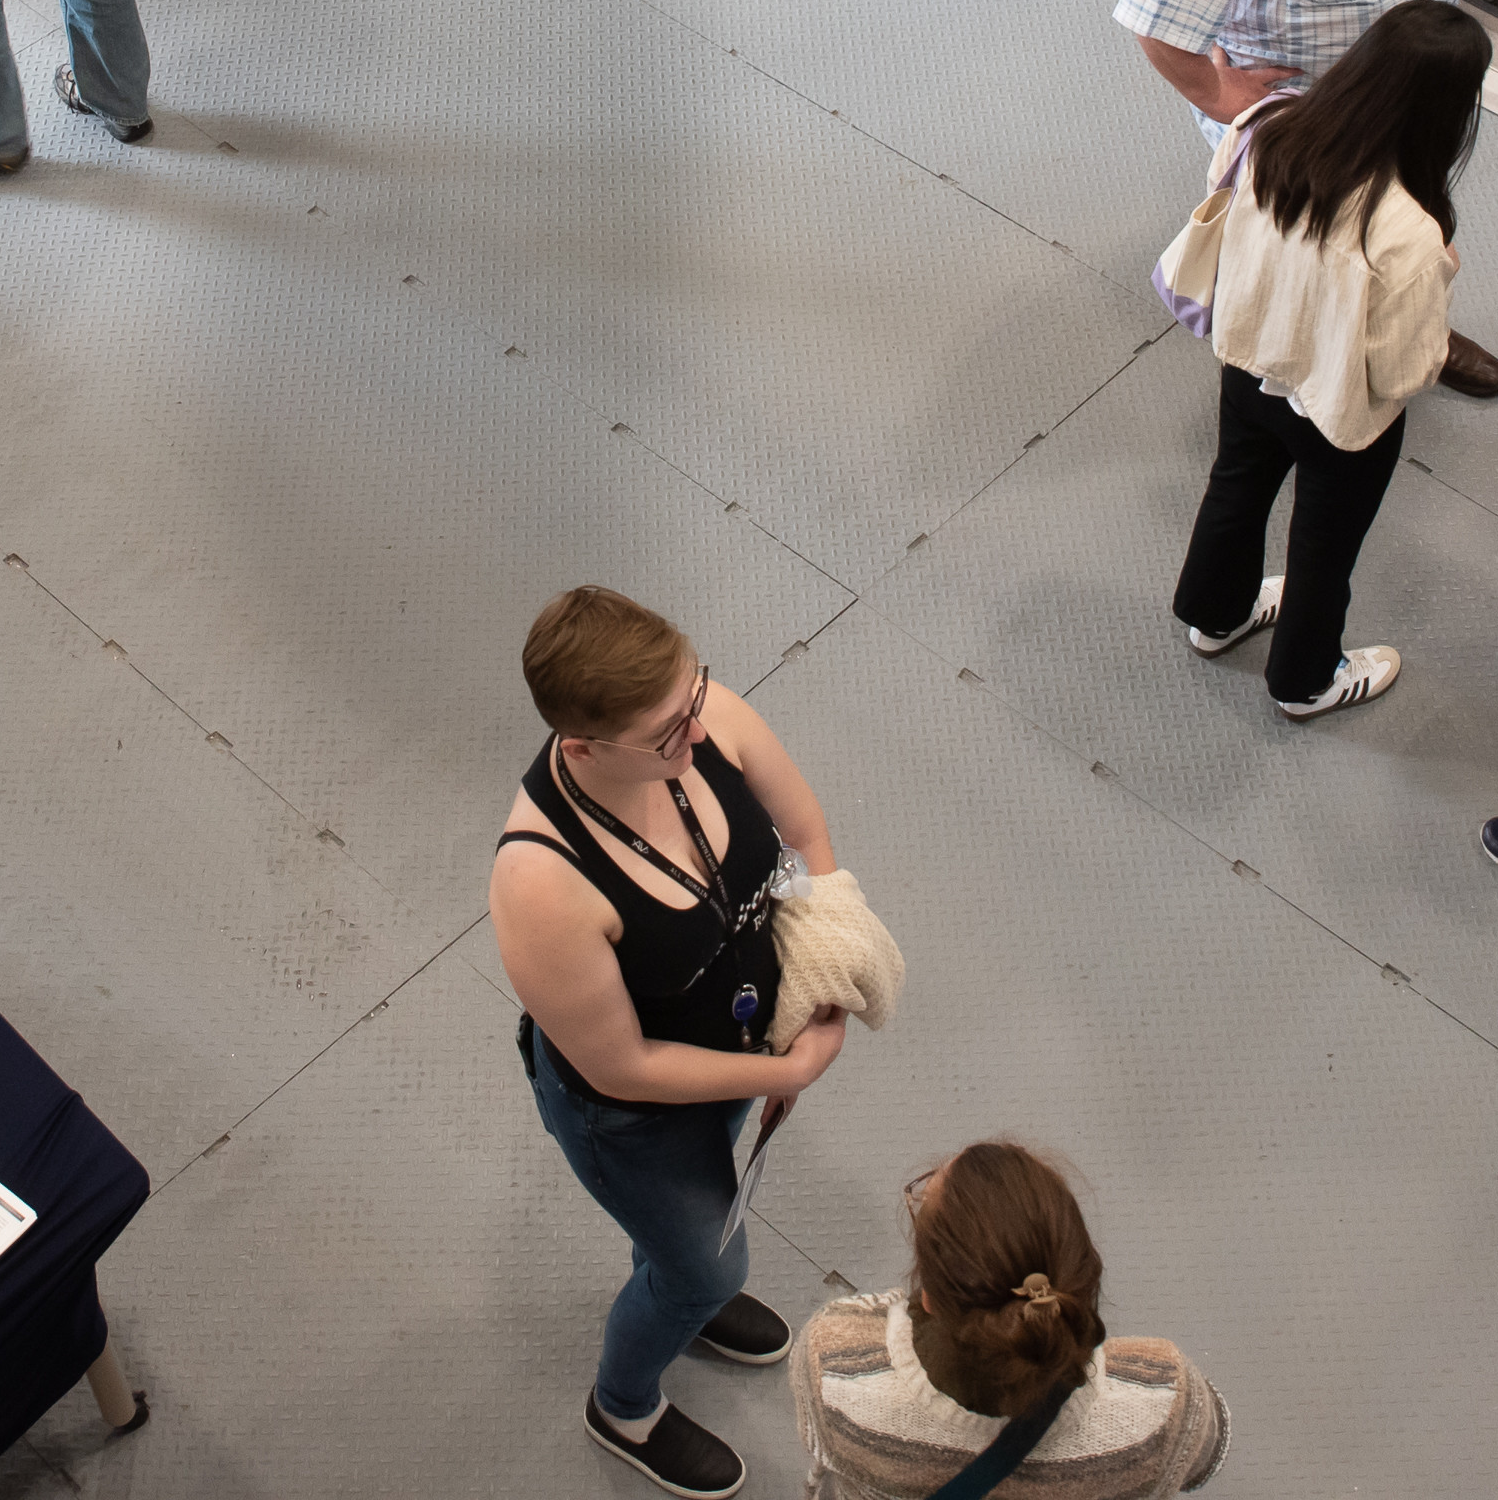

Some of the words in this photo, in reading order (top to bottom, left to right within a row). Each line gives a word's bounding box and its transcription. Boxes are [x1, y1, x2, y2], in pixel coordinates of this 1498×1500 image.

[694, 830, 718, 872] DOMINANCE
[669, 866, 682, 879] ALL
[684, 876, 708, 898] DOMAIN
